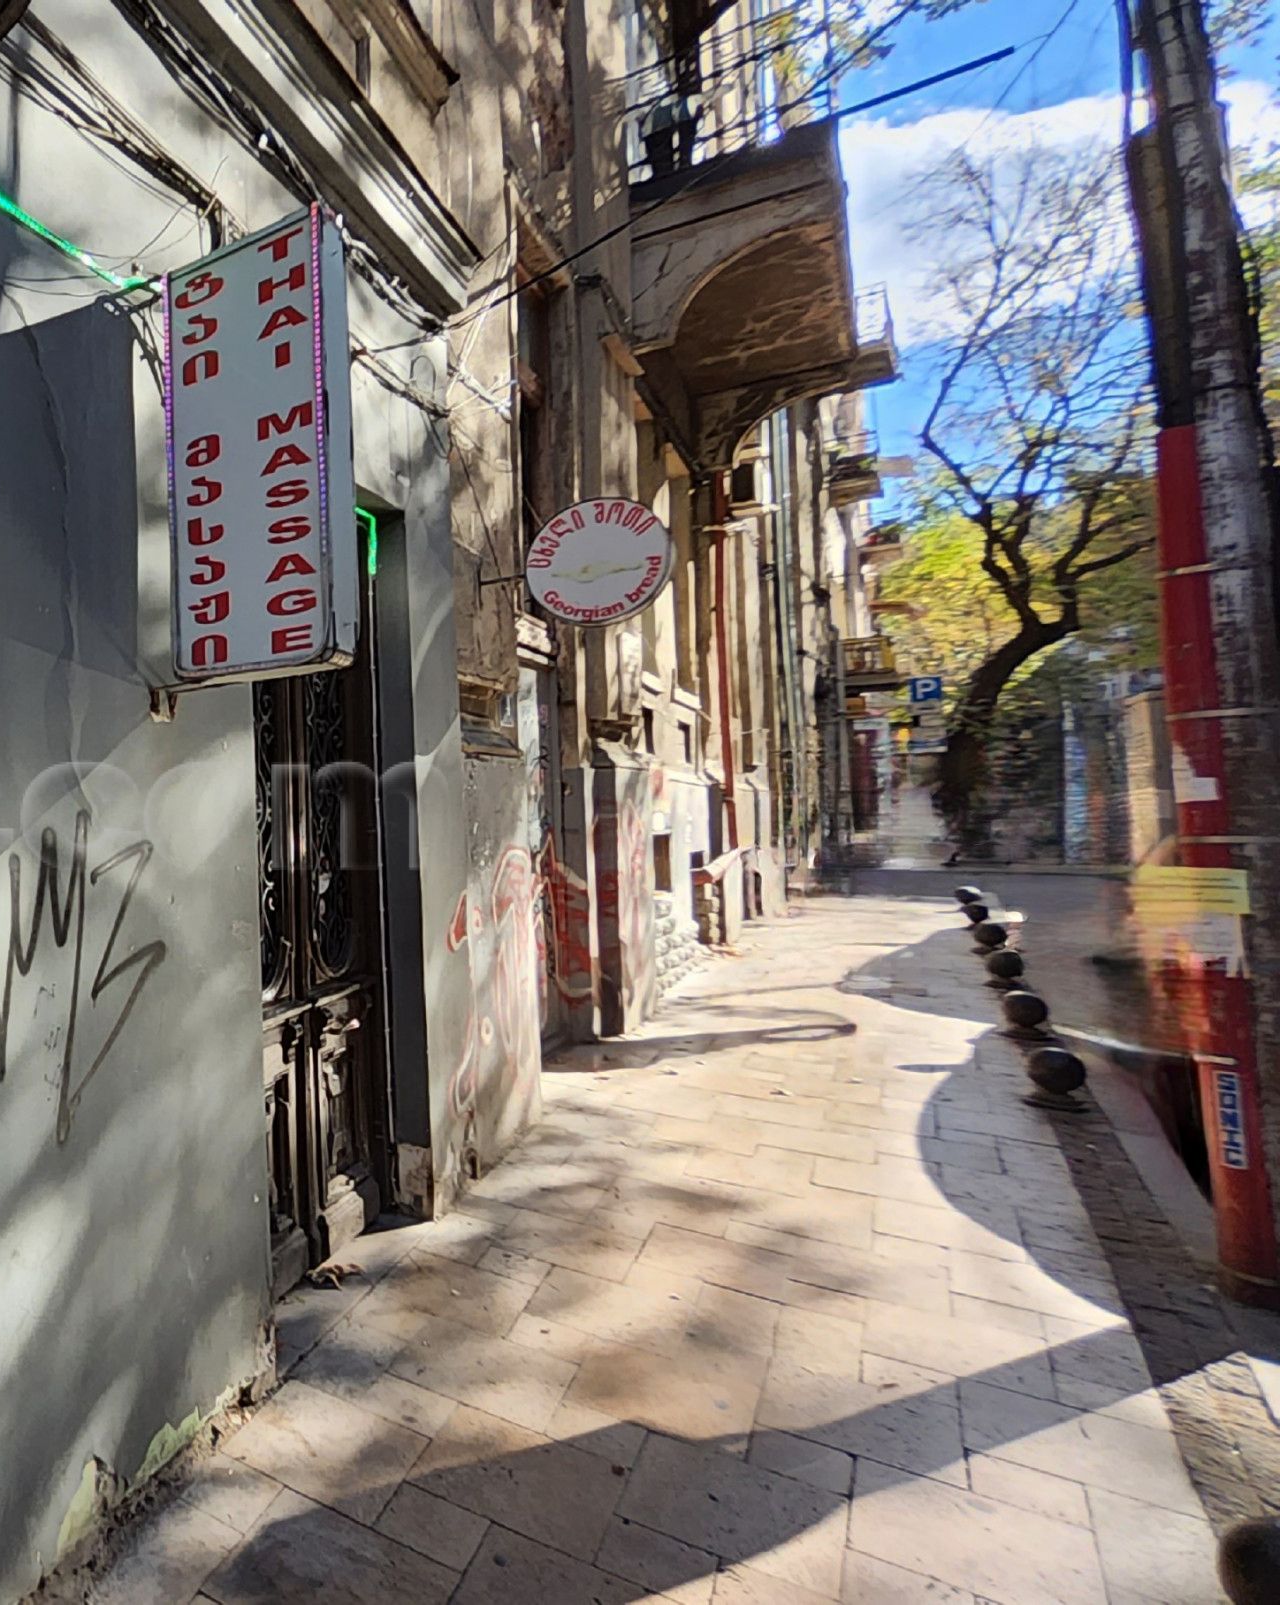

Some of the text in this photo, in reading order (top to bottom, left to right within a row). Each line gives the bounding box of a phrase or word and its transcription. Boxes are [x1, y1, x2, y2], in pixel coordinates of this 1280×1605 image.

[174, 271, 231, 667] ტაი მასაჟი
[256, 227, 318, 655] THAI MASSAGE
[528, 501, 658, 569] ცხელი შოთი
[543, 555, 663, 623] Georgian bread
[915, 678, 939, 700] P
[1216, 1073, 1242, 1166] SONIC
